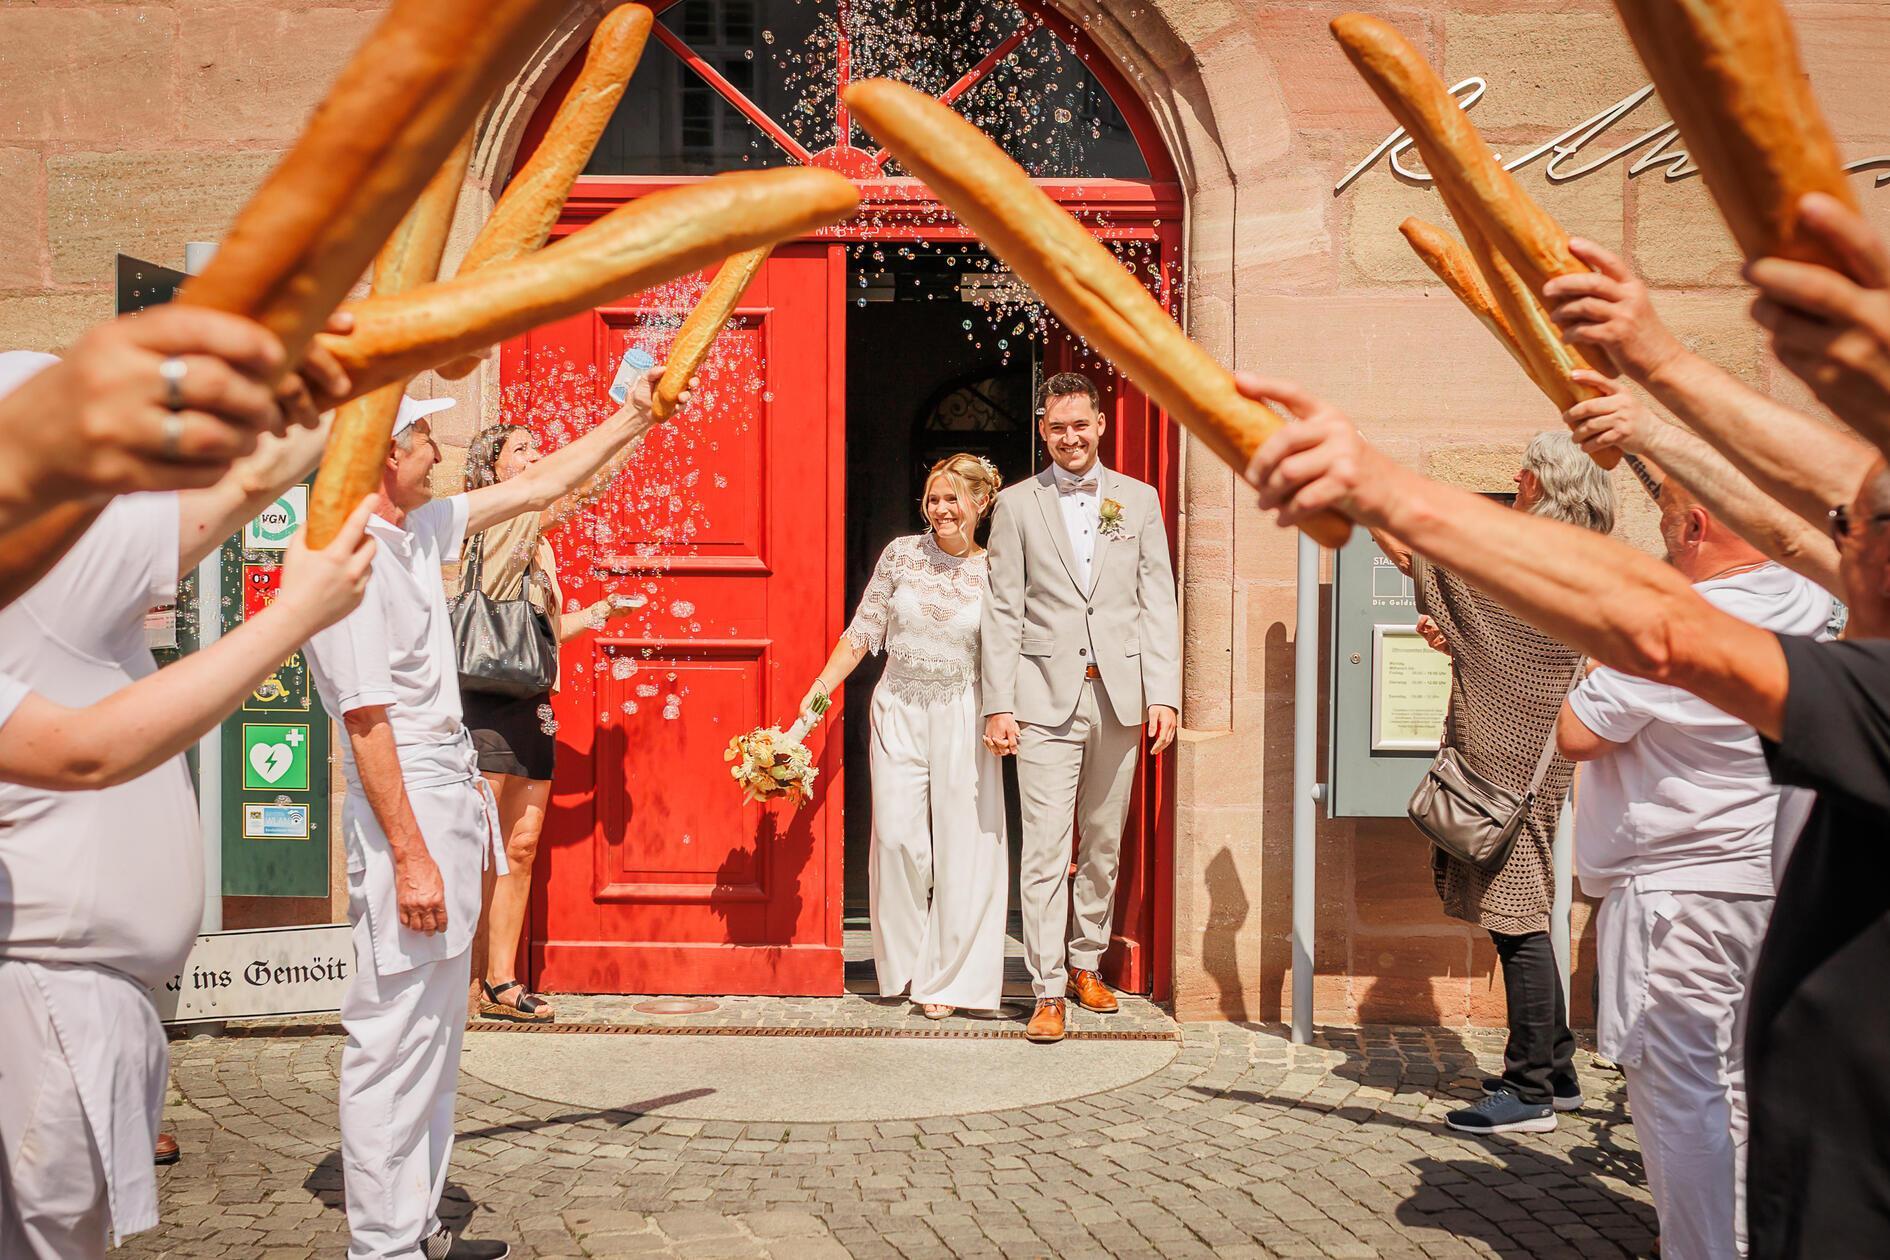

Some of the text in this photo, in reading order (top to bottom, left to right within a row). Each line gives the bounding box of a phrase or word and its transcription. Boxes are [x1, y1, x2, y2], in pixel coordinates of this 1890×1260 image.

[261, 514, 287, 524] VGN
[193, 966, 232, 989] ins
[243, 957, 346, 986] Gemöit
